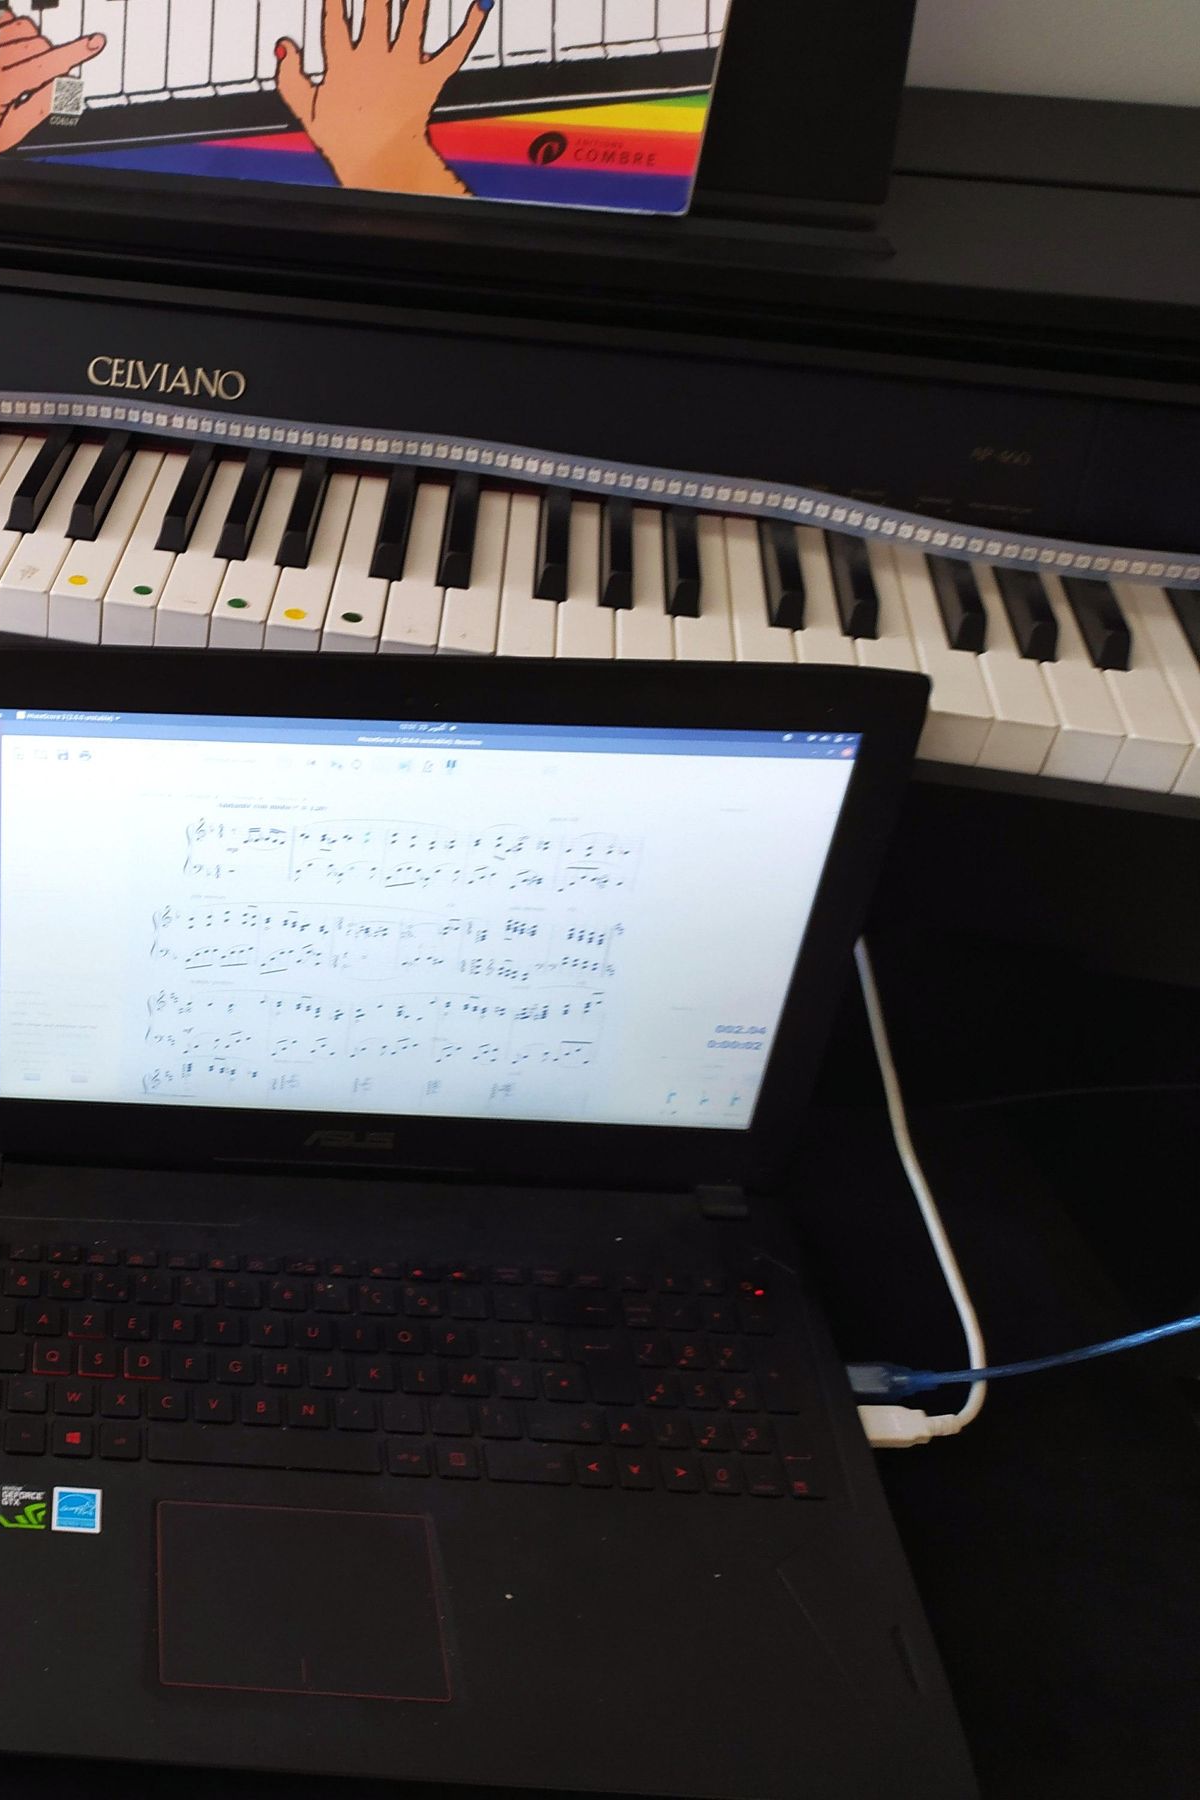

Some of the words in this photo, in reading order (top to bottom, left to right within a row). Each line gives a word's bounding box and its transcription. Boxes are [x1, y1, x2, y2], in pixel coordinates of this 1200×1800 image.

[573, 147, 658, 168] COMBRE
[86, 355, 247, 402] CELVIANO
[715, 1024, 768, 1036] 002.04
[706, 1039, 763, 1051] 0:00:02
[304, 1128, 396, 1151] ASUS
[37, 1312, 49, 1326] A
[82, 1313, 94, 1327] Z
[127, 1316, 137, 1330] E
[172, 1318, 184, 1331] R
[307, 1327, 320, 1338] U
[93, 1352, 104, 1366] S
[138, 1354, 151, 1368] D
[184, 1356, 194, 1370] F
[228, 1360, 243, 1373] G
[275, 1362, 289, 1375] H
[368, 1366, 380, 1379] K
[462, 1372, 477, 1385] M
[66, 1390, 82, 1403] W
[115, 1393, 127, 1406] X
[161, 1394, 173, 1409] C
[256, 1400, 267, 1414] B
[302, 1403, 317, 1417] N
[1, 1490, 45, 1501] GEFORCE
[1, 1499, 20, 1507] GTX
